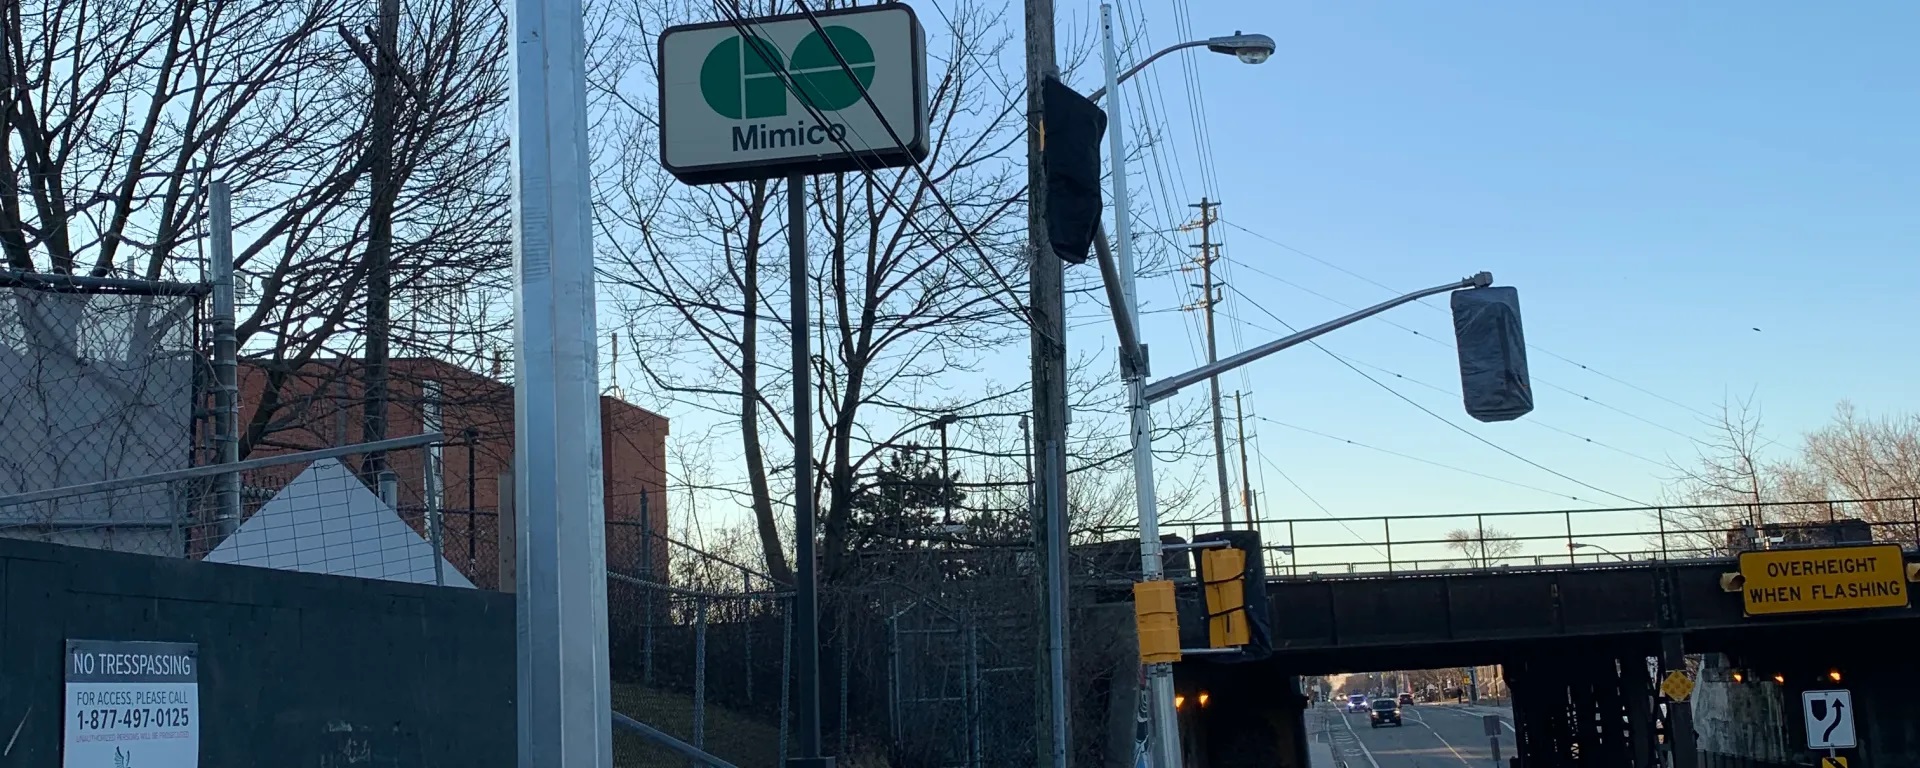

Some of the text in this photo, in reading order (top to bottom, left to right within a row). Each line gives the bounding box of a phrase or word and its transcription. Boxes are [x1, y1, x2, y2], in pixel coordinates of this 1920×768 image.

[732, 121, 847, 152] Mimico
[1767, 557, 1877, 578] OVERHEIGHT
[1750, 581, 1900, 603] WHEN FLASHING
[74, 653, 191, 675] NO TRESSPASSING
[77, 690, 188, 706] FOR ACCESS, PLEASE CALL
[77, 708, 189, 730] 1-877-497-0125
